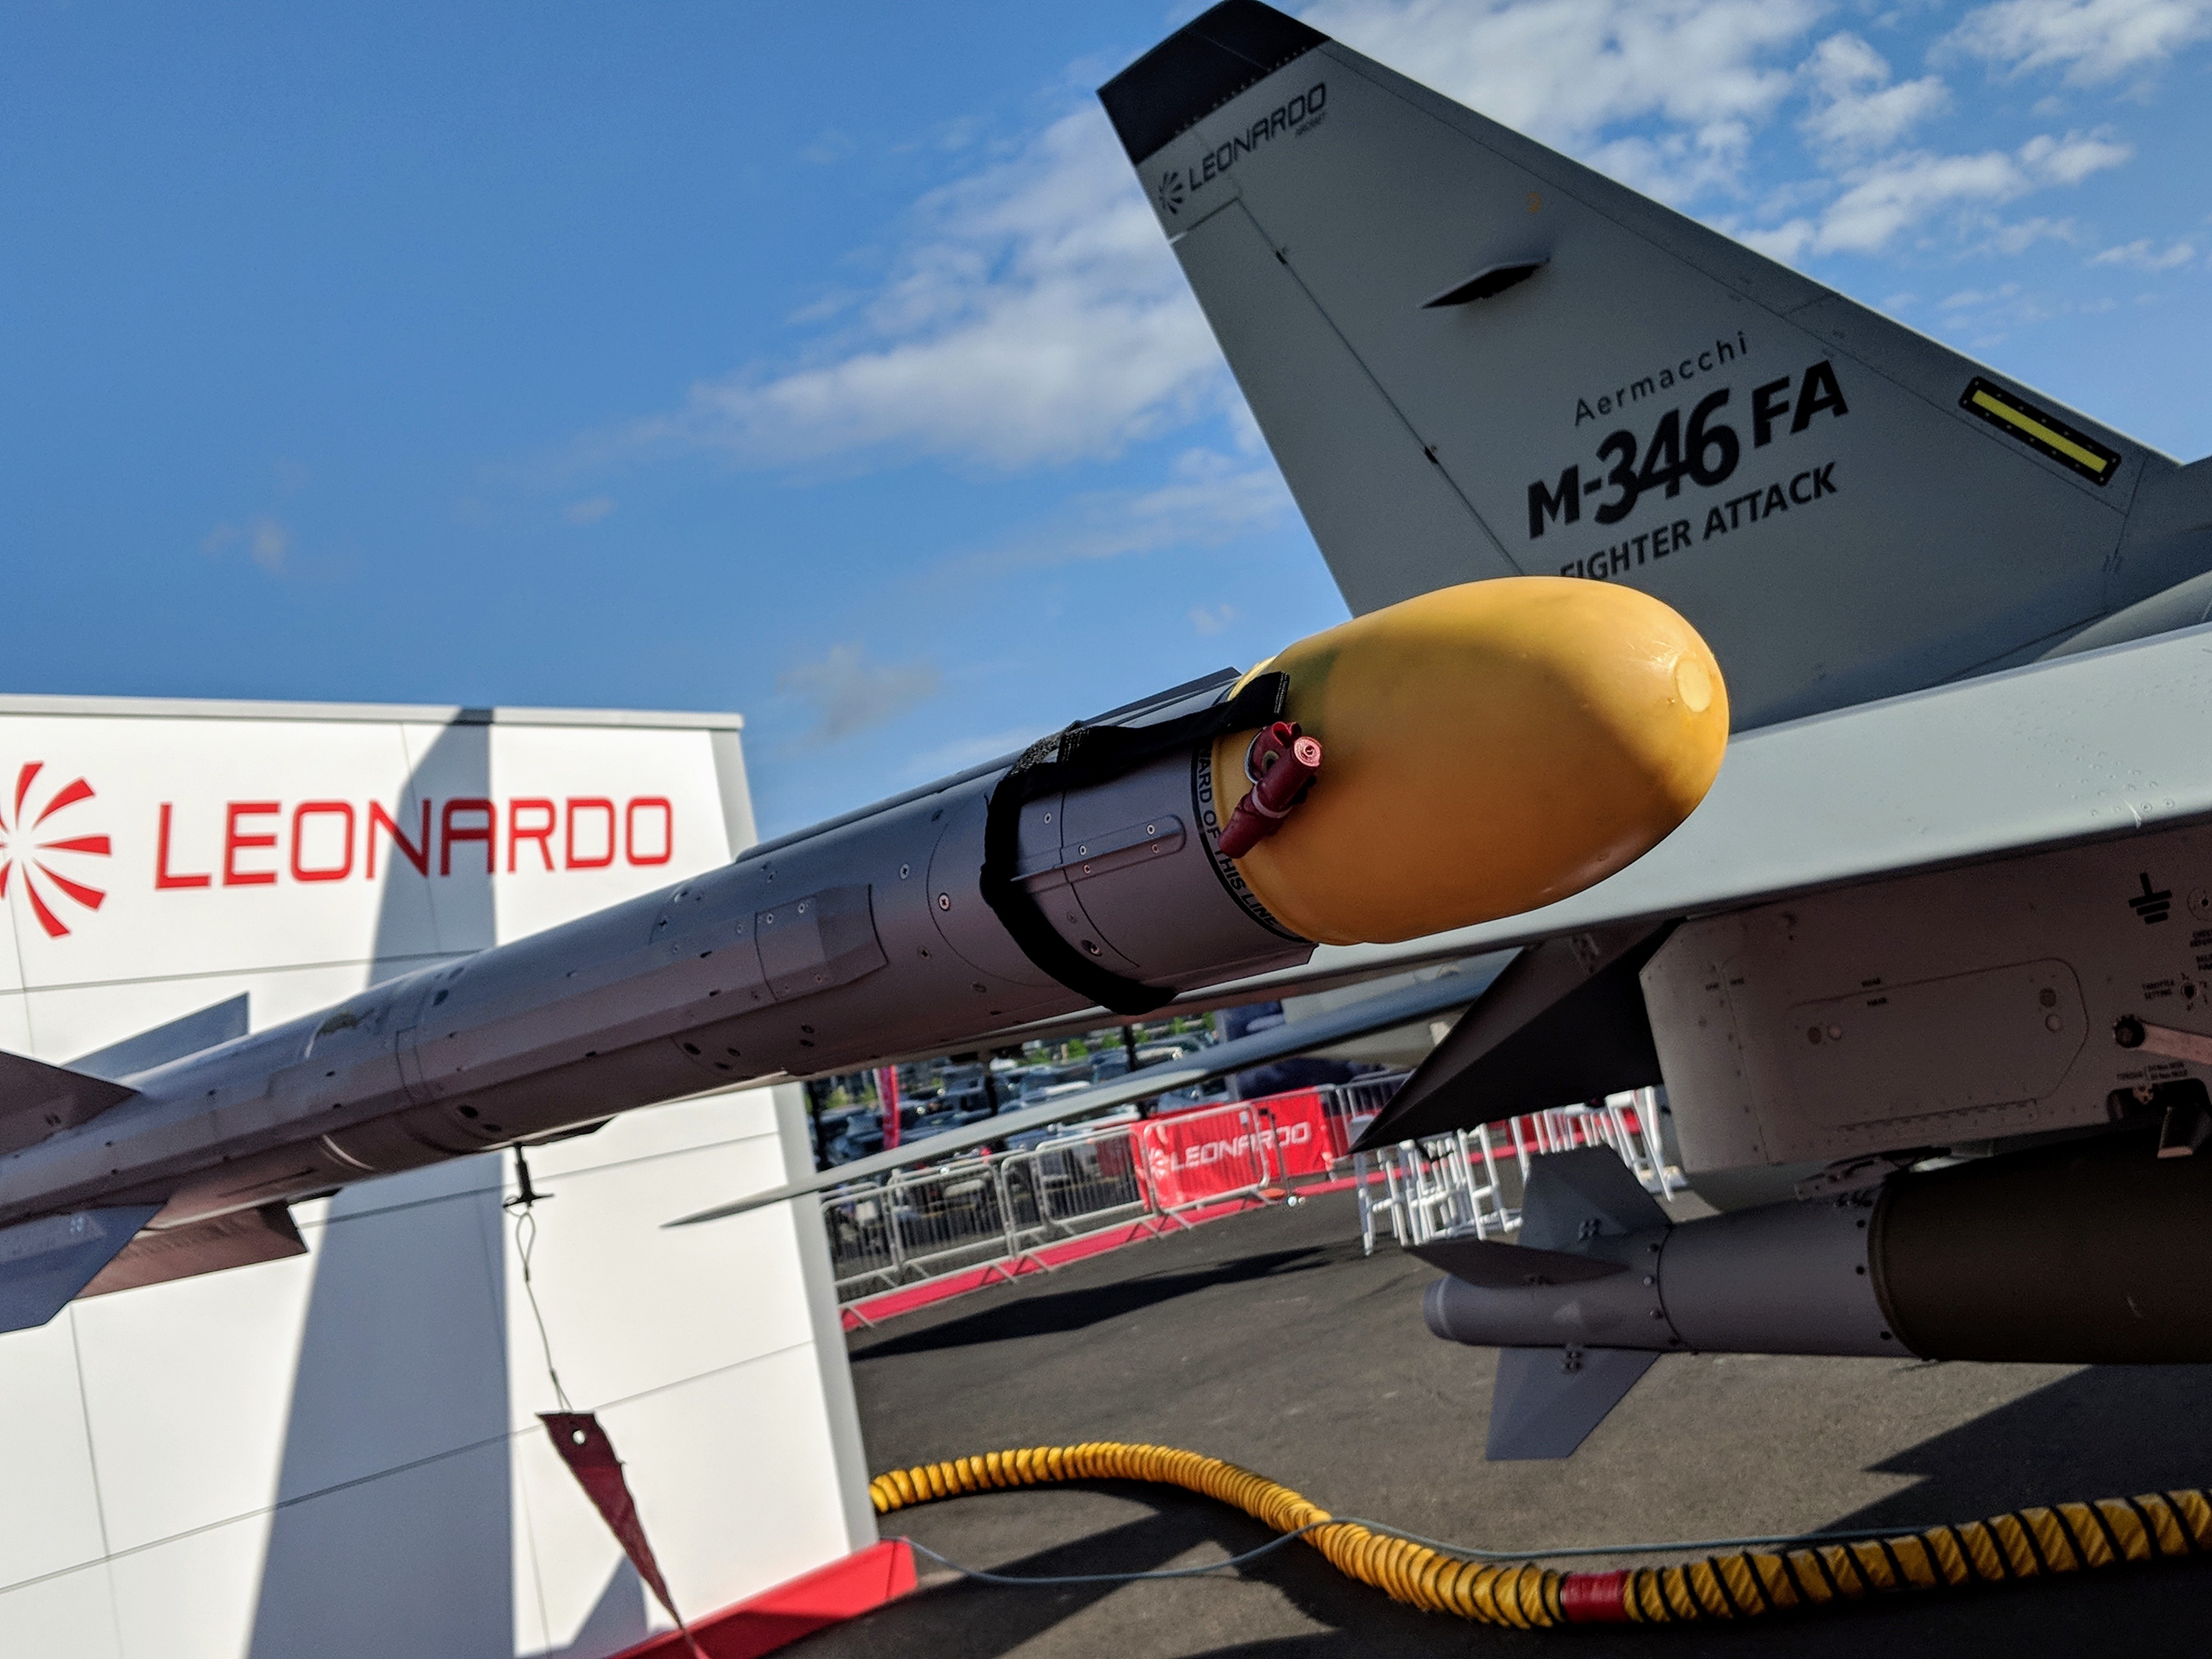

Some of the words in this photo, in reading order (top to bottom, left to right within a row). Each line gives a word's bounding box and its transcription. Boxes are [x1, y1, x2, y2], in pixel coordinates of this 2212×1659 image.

[1188, 82, 1327, 192] LEONARDO
[1574, 330, 1747, 427] Aermacchi
[1527, 387, 1740, 540] M-346
[1751, 359, 1849, 449] FA
[1702, 461, 1837, 541] ATTACK
[154, 795, 673, 890] LEONARDO
[1203, 809, 1221, 839] OF
[1240, 893, 1279, 927] LINE
[1170, 1120, 1311, 1171] LEONARDO
